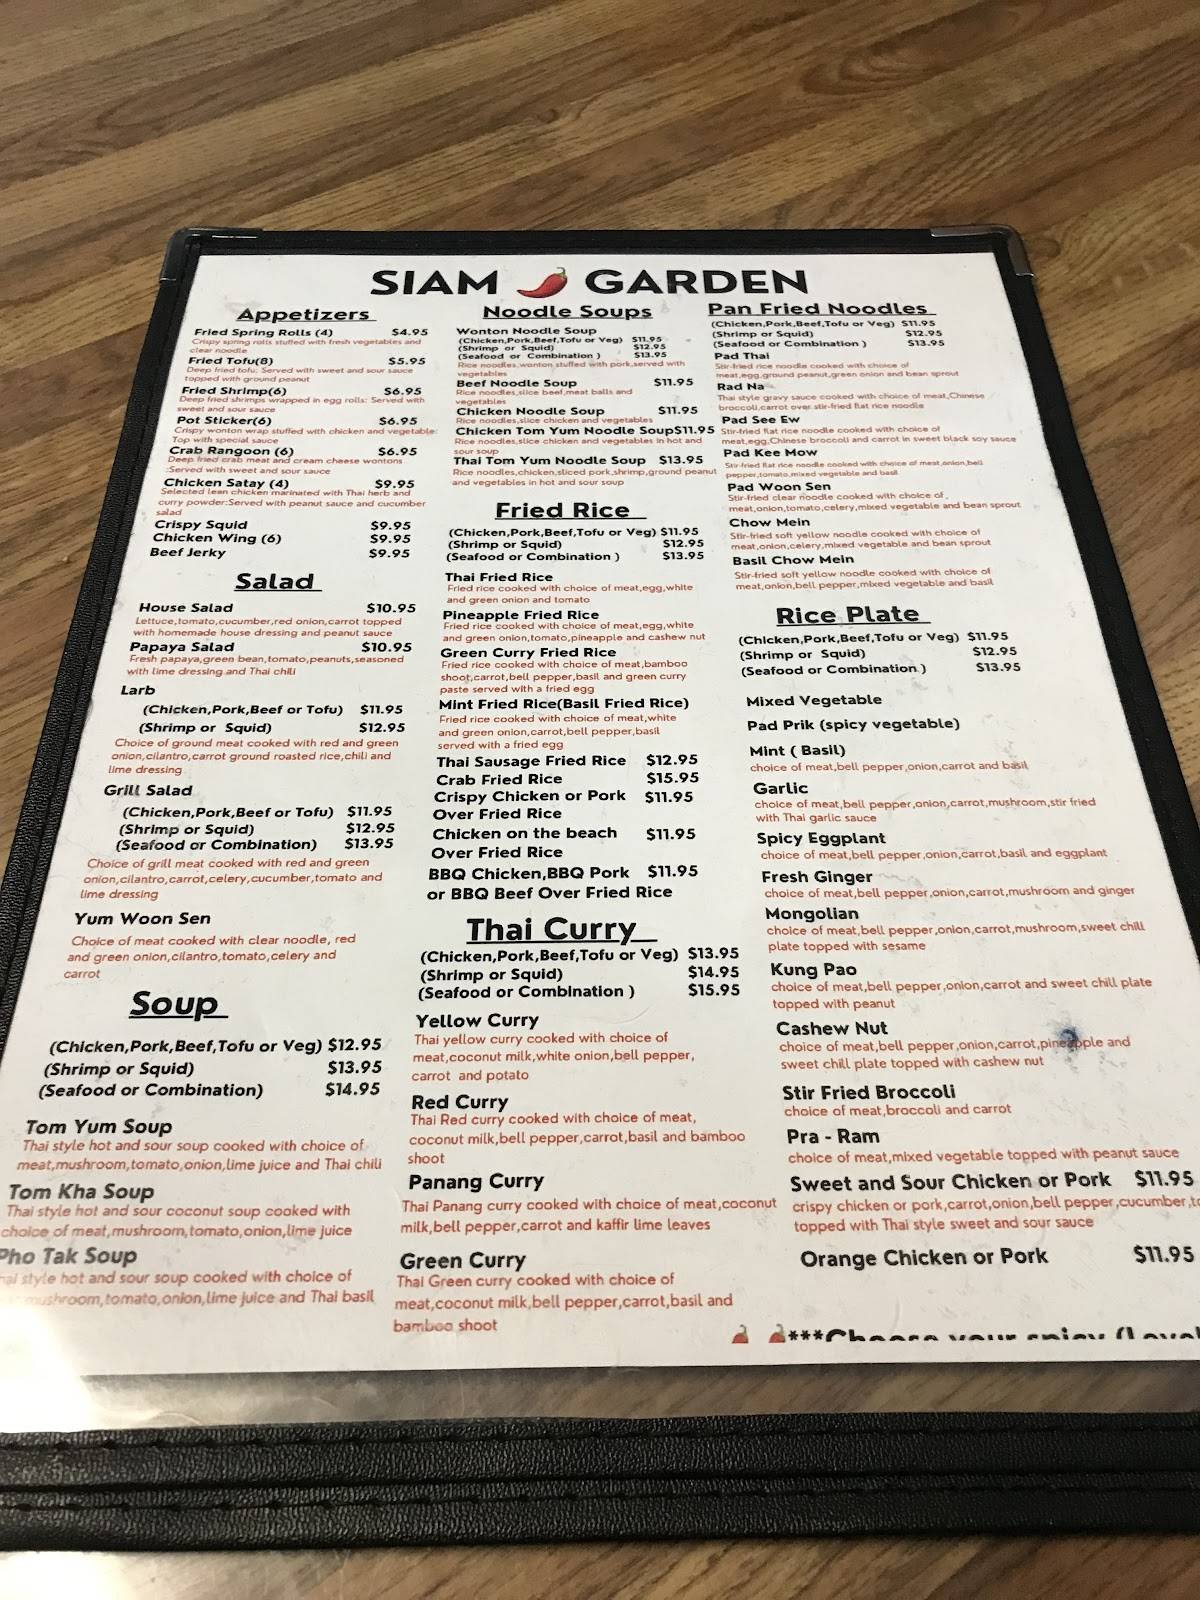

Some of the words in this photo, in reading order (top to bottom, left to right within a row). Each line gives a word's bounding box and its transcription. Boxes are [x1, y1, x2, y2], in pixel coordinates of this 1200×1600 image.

[370, 270, 498, 296] SIAM
[585, 269, 808, 295] GARDEN
[236, 308, 370, 323] Appetizers
[483, 305, 572, 318] Noodle
[580, 305, 652, 318] Soups
[708, 303, 752, 315] Pan
[760, 302, 820, 314] Fried
[828, 302, 928, 314] Noodles
[867, 320, 895, 328] Veg)
[194, 328, 229, 336] Fried
[231, 328, 275, 339] Spring
[278, 329, 311, 337] Rolls
[315, 328, 333, 338] (4)
[392, 328, 428, 337] $4.95
[512, 327, 561, 335] Noodle
[564, 327, 597, 336] Soup
[188, 356, 223, 365] Fried
[226, 357, 274, 367] Tofu(8)
[388, 356, 426, 366] $5.95
[714, 352, 739, 360] Pad
[742, 352, 770, 360] Thai
[456, 379, 487, 388] Beef
[490, 379, 540, 388] Noodle
[543, 379, 578, 389] Soup
[654, 377, 694, 387] $11.95
[722, 416, 748, 425] Pad
[751, 415, 777, 424] See
[780, 415, 800, 424] Ew
[169, 446, 203, 455] Crab
[207, 446, 270, 458] Rangoon
[274, 447, 294, 458] (6)
[378, 447, 417, 457] $6.95
[163, 478, 222, 487] Chicken
[226, 478, 266, 490] Satay
[269, 479, 289, 490] (4)
[375, 479, 415, 489] $9.95
[727, 483, 754, 492] Pad
[758, 483, 802, 492] Woon
[805, 482, 831, 491] Sen
[496, 502, 563, 518] Fried
[573, 502, 630, 518] Rice
[154, 519, 202, 531] Crispy
[205, 520, 248, 532] Squid
[370, 520, 411, 531] $9.95
[149, 547, 185, 557] Beef
[186, 547, 227, 560] Jerky
[368, 548, 410, 559] $9.95
[732, 556, 767, 566] Basil
[771, 555, 815, 565] Chow
[819, 554, 855, 564] Mein
[235, 572, 314, 590] Salad
[139, 602, 187, 613] House
[190, 603, 234, 613] Salad
[366, 602, 416, 614] $10.95
[776, 607, 837, 625] Rice
[846, 605, 919, 623] Plate
[443, 610, 519, 622] Pineapple
[524, 610, 563, 620] Fried
[567, 610, 600, 620] Rice
[120, 685, 156, 695] Larb
[746, 695, 795, 707] Mixed
[799, 694, 882, 708] Vegetable
[436, 756, 470, 768] Thai
[474, 756, 541, 769] Sausage
[546, 755, 586, 766] Fried
[592, 755, 627, 766] Rice
[646, 753, 698, 767] $12.95
[135, 764, 183, 777] dressing
[104, 784, 140, 796] Grill
[145, 784, 193, 796] Salad
[753, 782, 809, 795] Garlic
[809, 813, 842, 825] garlic
[432, 828, 501, 841] Chicken
[506, 830, 528, 839] on
[532, 827, 561, 839] the
[566, 826, 617, 839] beach
[646, 827, 696, 842] $11.95
[757, 832, 803, 847] Spicy
[808, 831, 887, 847] Eggplant
[74, 912, 114, 926] Yum
[120, 912, 173, 925] Woon
[178, 912, 211, 925] Sen
[765, 907, 859, 923] Mongolian
[466, 917, 532, 941] Thai
[544, 916, 637, 945] Curry
[770, 962, 818, 980] Kung
[823, 962, 857, 976] Pao
[129, 990, 218, 1021] Soup
[415, 1014, 482, 1029] Yellow
[487, 1012, 539, 1030] Curry
[776, 1021, 850, 1036] Cashew
[855, 1021, 889, 1035] Nut
[411, 1071, 451, 1082] carrot
[458, 1069, 482, 1081] and
[486, 1070, 529, 1083] potato
[38, 1083, 117, 1101] (Seafood
[120, 1086, 140, 1097] or
[144, 1083, 263, 1100] Combination)
[325, 1081, 380, 1097] $14.95
[782, 1085, 815, 1101] Stir
[821, 1085, 870, 1100] Fried
[875, 1084, 956, 1100] Broccoli
[411, 1094, 449, 1110] Red
[455, 1094, 509, 1113] Curry
[784, 1105, 829, 1117] choice
[832, 1104, 846, 1116] of
[945, 1103, 970, 1115] and
[973, 1104, 1012, 1115] carrot
[26, 1120, 67, 1135] Tom
[74, 1119, 117, 1134] Yum
[122, 1118, 173, 1138] Soup
[409, 1174, 482, 1193] Panang
[489, 1172, 545, 1192] Curry
[9, 1184, 52, 1200] Tom
[57, 1183, 97, 1200] Kha
[102, 1183, 155, 1204] Soup
[400, 1252, 462, 1270] Green
[469, 1251, 527, 1272] Curry
[800, 1250, 877, 1271] Orange
[883, 1249, 967, 1266] Chicken
[973, 1251, 994, 1265] or
[1000, 1247, 1049, 1264] Pork
[1133, 1244, 1195, 1264] $11.95
